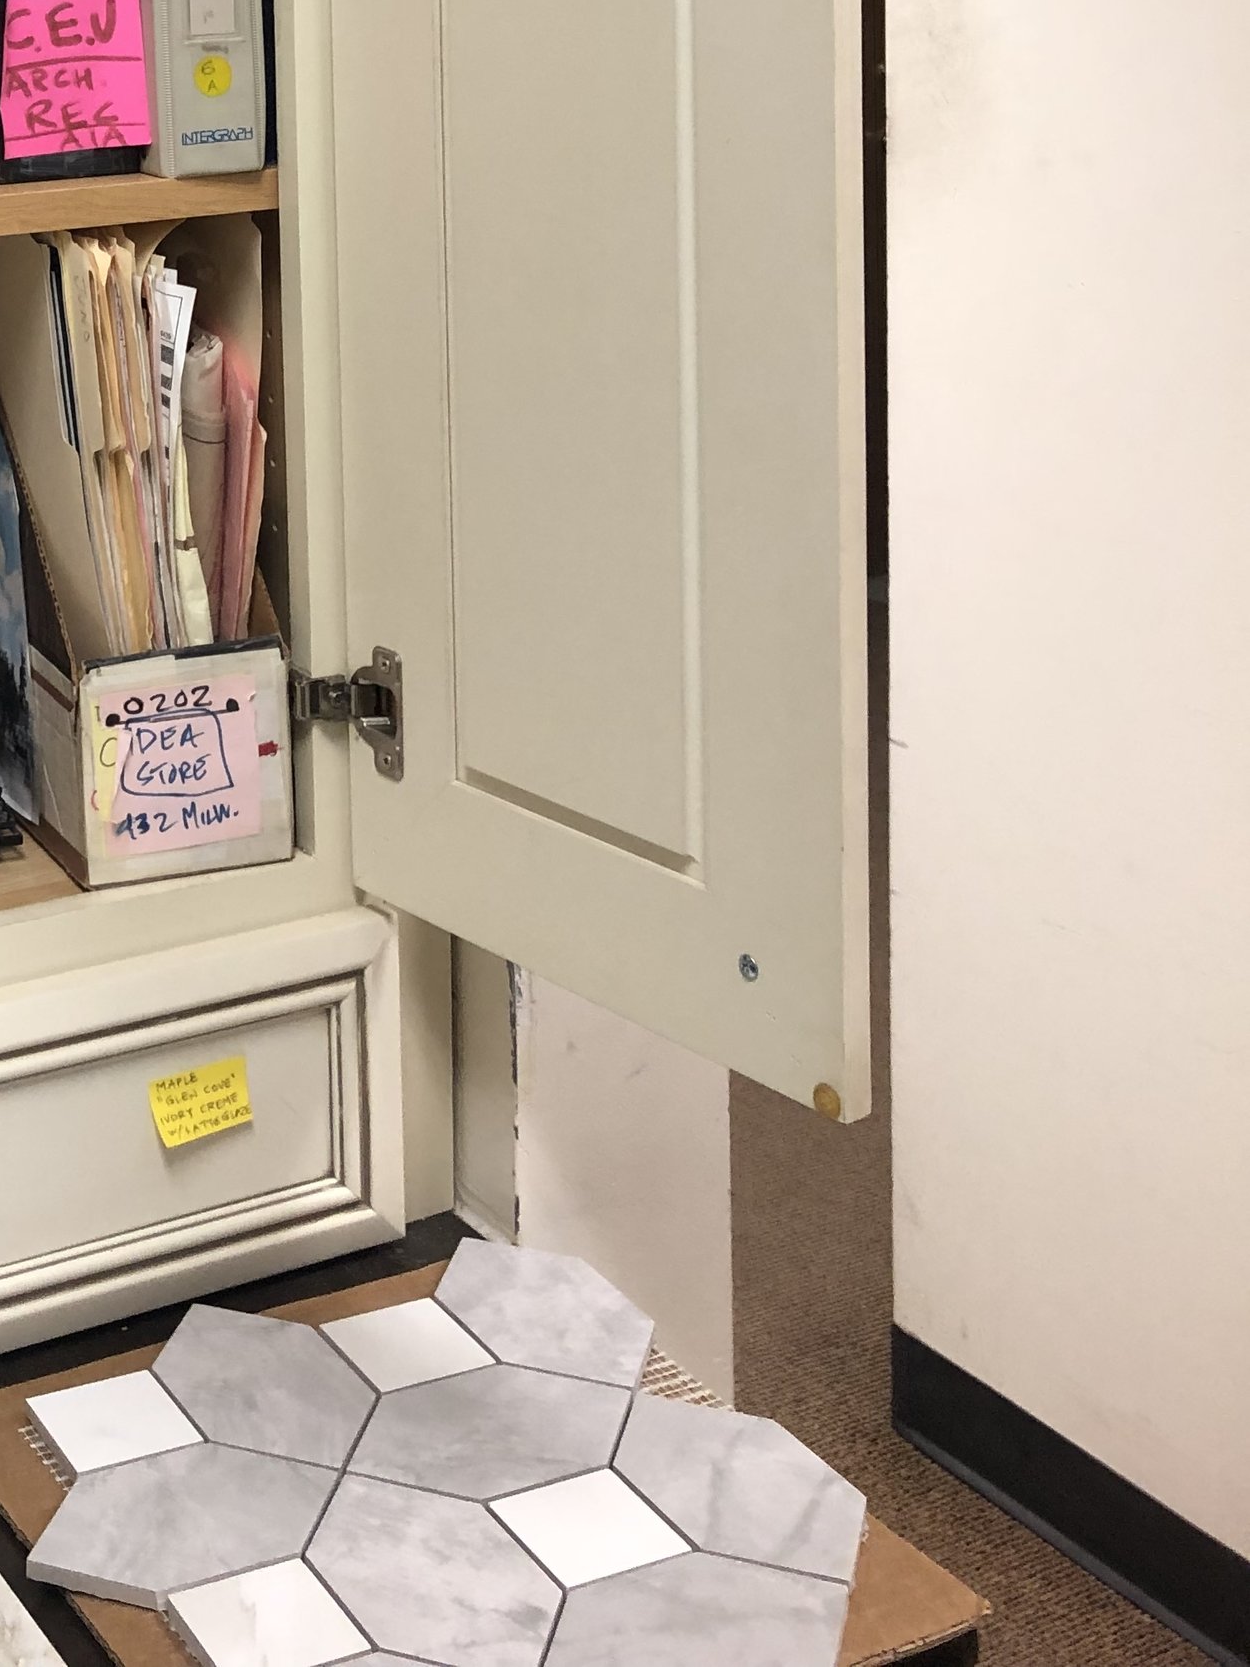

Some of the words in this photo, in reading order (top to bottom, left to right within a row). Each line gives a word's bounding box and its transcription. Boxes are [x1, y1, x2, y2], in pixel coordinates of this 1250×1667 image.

[207, 79, 218, 93] A
[25, 99, 119, 134] REC
[60, 125, 127, 151] AIA
[181, 127, 253, 146] INTERGRAPH
[136, 754, 212, 786] STORE
[155, 1072, 199, 1093] MAPLE
[160, 1107, 194, 1126] IVORY
[200, 1092, 238, 1114] CREME
